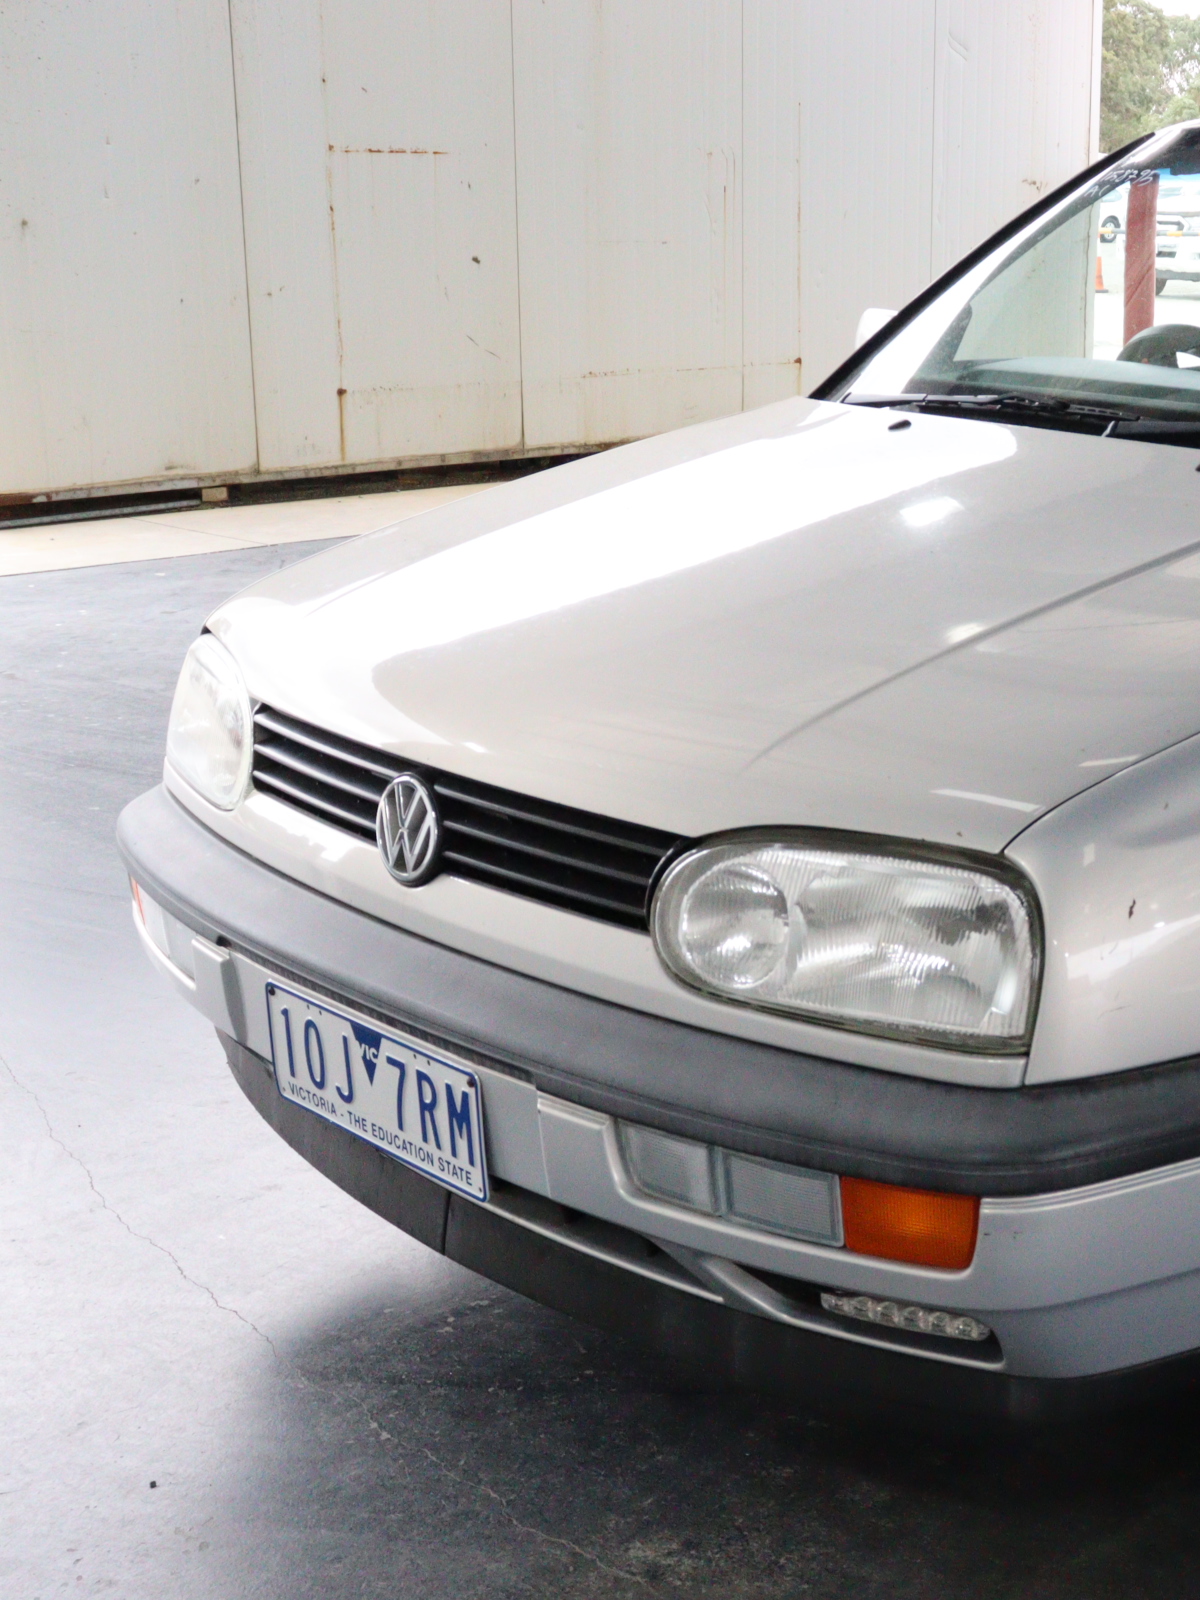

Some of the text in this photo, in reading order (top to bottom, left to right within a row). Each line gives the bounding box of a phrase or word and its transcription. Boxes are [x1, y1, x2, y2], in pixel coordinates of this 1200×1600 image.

[378, 778, 435, 878] VW
[357, 1041, 379, 1064] VIC
[288, 1081, 337, 1118] VICTORIA
[347, 1110, 368, 1133] THE
[371, 1124, 435, 1168] EDUCATION
[438, 1156, 473, 1187] STATE
[386, 1053, 476, 1168] 7RM
